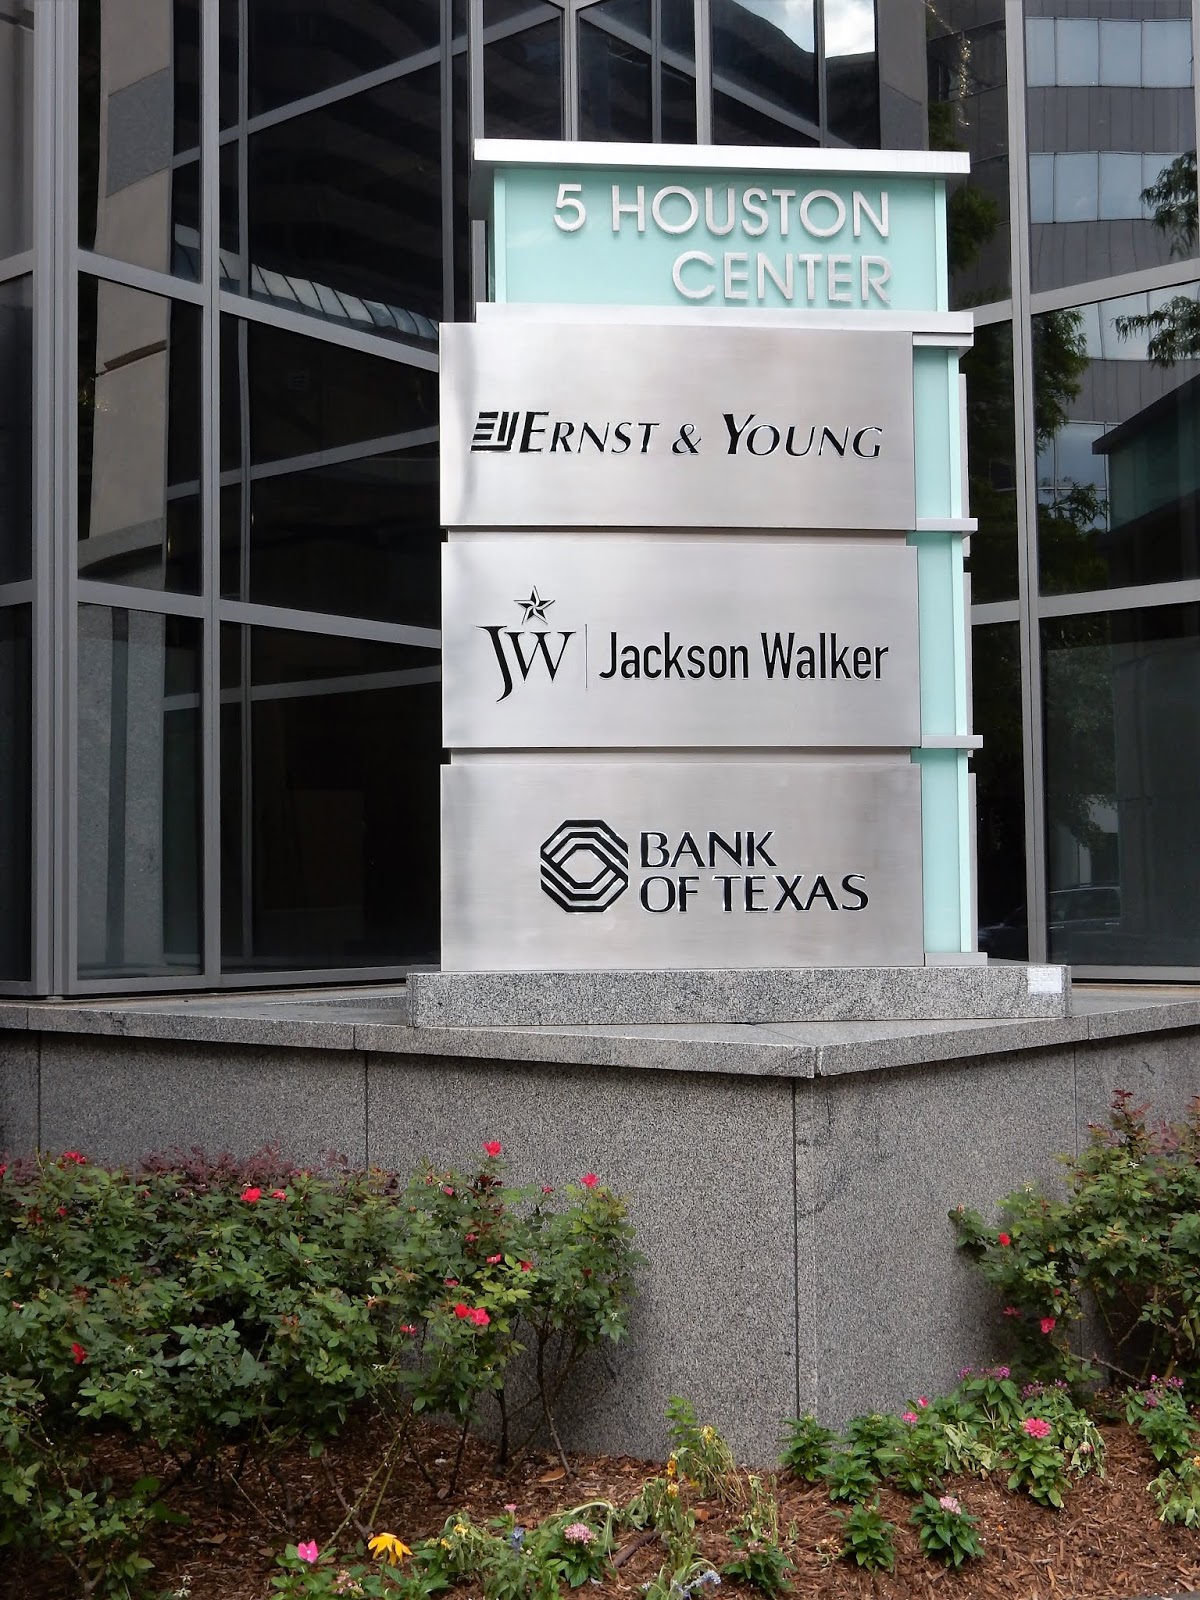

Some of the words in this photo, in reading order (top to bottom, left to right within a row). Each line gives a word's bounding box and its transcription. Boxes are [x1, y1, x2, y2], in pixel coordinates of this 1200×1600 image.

[552, 183, 587, 232] 5
[611, 184, 890, 238] HOUSTON
[671, 250, 892, 303] CENTER
[519, 411, 661, 454] ERNST
[672, 422, 703, 455] &
[722, 412, 884, 459] YOUNG
[476, 625, 577, 703] JW
[599, 631, 751, 680] Jackson
[760, 632, 890, 681] Walker
[639, 830, 777, 868] BANK
[640, 875, 701, 913] OF
[711, 874, 869, 912] TEXAS
